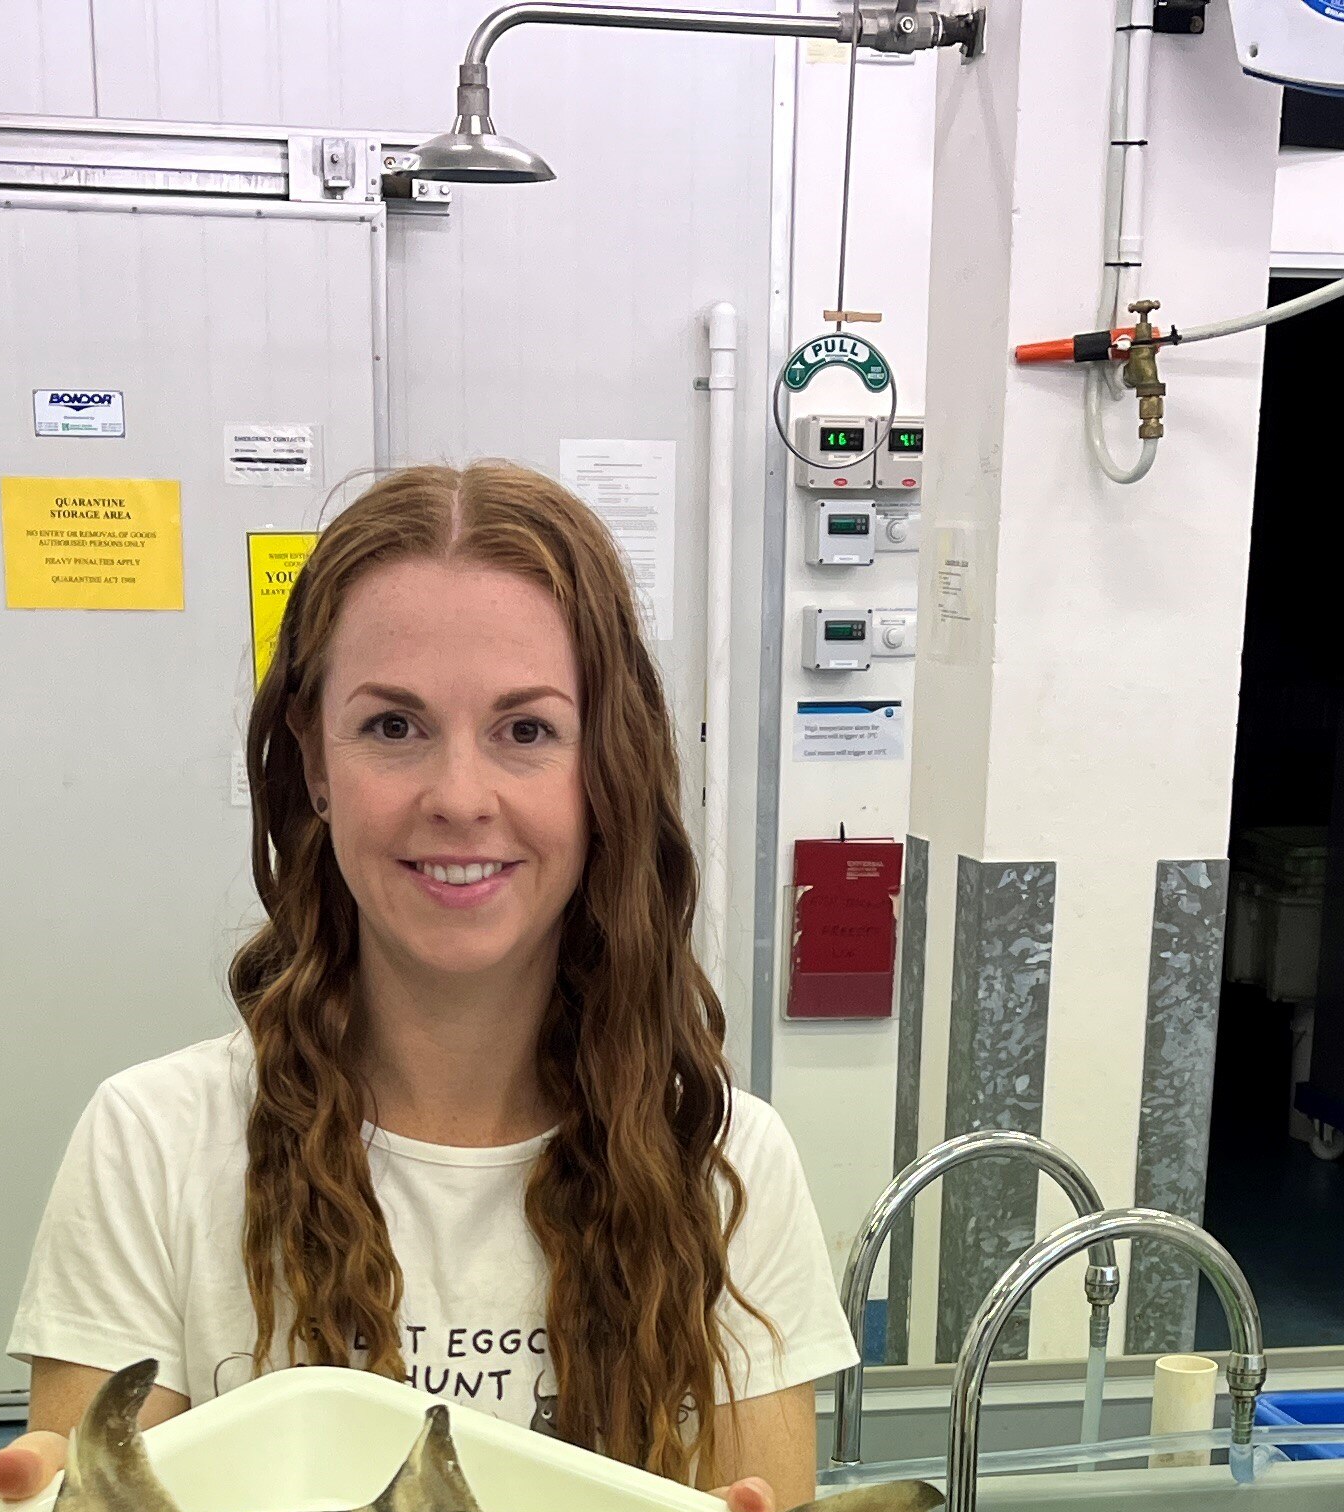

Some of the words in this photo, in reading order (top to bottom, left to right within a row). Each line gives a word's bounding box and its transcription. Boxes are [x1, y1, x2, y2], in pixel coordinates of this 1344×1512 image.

[811, 339, 860, 358] PULL
[48, 392, 112, 404] BONDOR
[55, 497, 126, 508] QUARANTINE
[50, 509, 100, 519] STORAGE
[103, 510, 132, 520] AREA
[39, 530, 65, 538] ENTRY
[79, 530, 117, 538] REMOVAL
[89, 540, 124, 548] PERSONS
[124, 540, 146, 548] ONLY
[74, 558, 116, 566] PENALTIES
[116, 558, 141, 566] APPLY
[52, 576, 102, 584] QUARANTINE
[260, 588, 286, 596] LEAVE
[447, 1327, 547, 1358] EGGC
